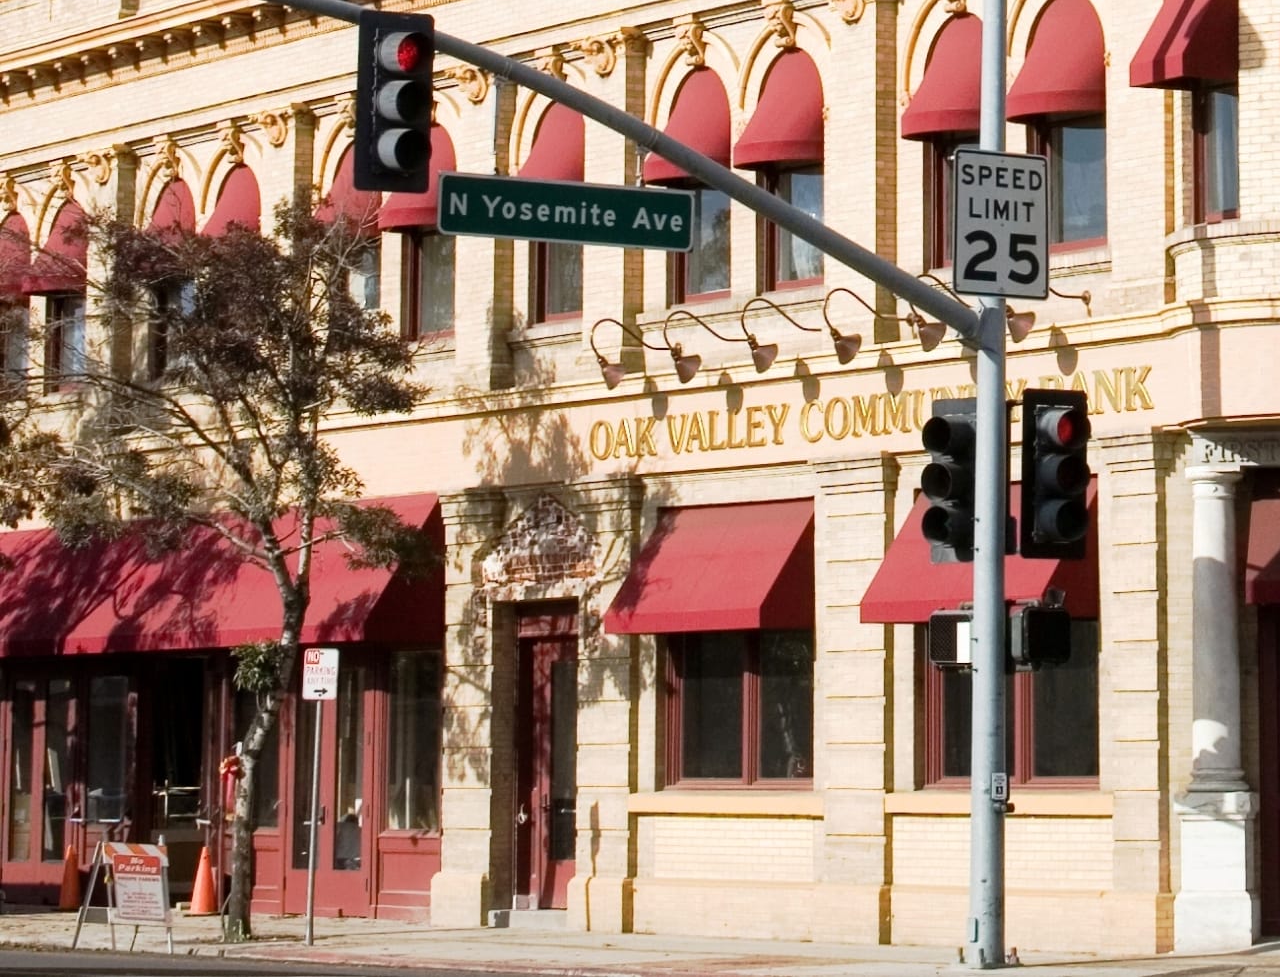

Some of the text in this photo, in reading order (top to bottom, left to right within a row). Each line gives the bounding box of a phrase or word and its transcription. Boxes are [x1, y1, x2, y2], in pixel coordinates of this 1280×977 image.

[962, 164, 1043, 191] SPEED
[449, 192, 684, 232] N Yosemite Ave
[969, 197, 1034, 222] LIMIT
[963, 230, 1040, 285] 25
[589, 417, 657, 460] OAK
[666, 403, 790, 454] VALLEY
[1202, 438, 1280, 463] FIRST
[308, 651, 319, 662] NO
[306, 666, 336, 675] PARKING
[118, 864, 158, 873] Parking
[130, 857, 144, 865] No
